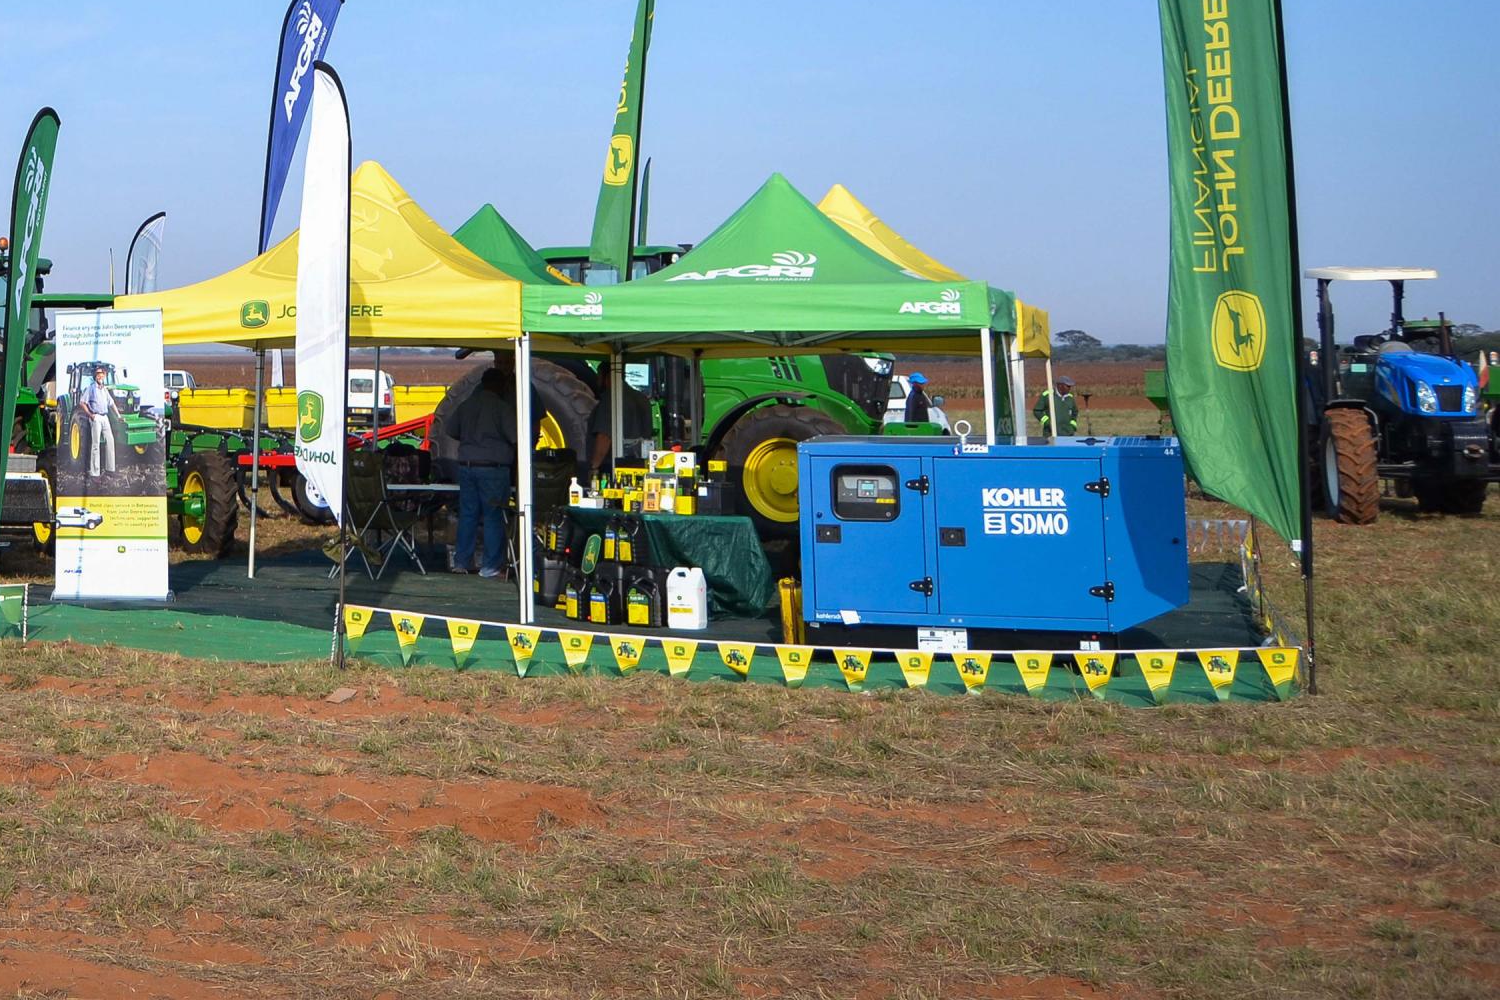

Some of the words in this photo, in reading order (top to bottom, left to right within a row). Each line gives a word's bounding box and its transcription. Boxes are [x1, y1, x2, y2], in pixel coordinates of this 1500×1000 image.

[284, 12, 323, 122] AFGRI
[664, 265, 815, 282] AFGRI
[277, 305, 297, 319] JO
[350, 305, 383, 317] ERE
[547, 304, 603, 316] AFGRI
[898, 302, 961, 314] AFGRI
[1164, 448, 1174, 456] 44
[982, 487, 1067, 507] KOHLER
[1010, 513, 1069, 536] SDMO
